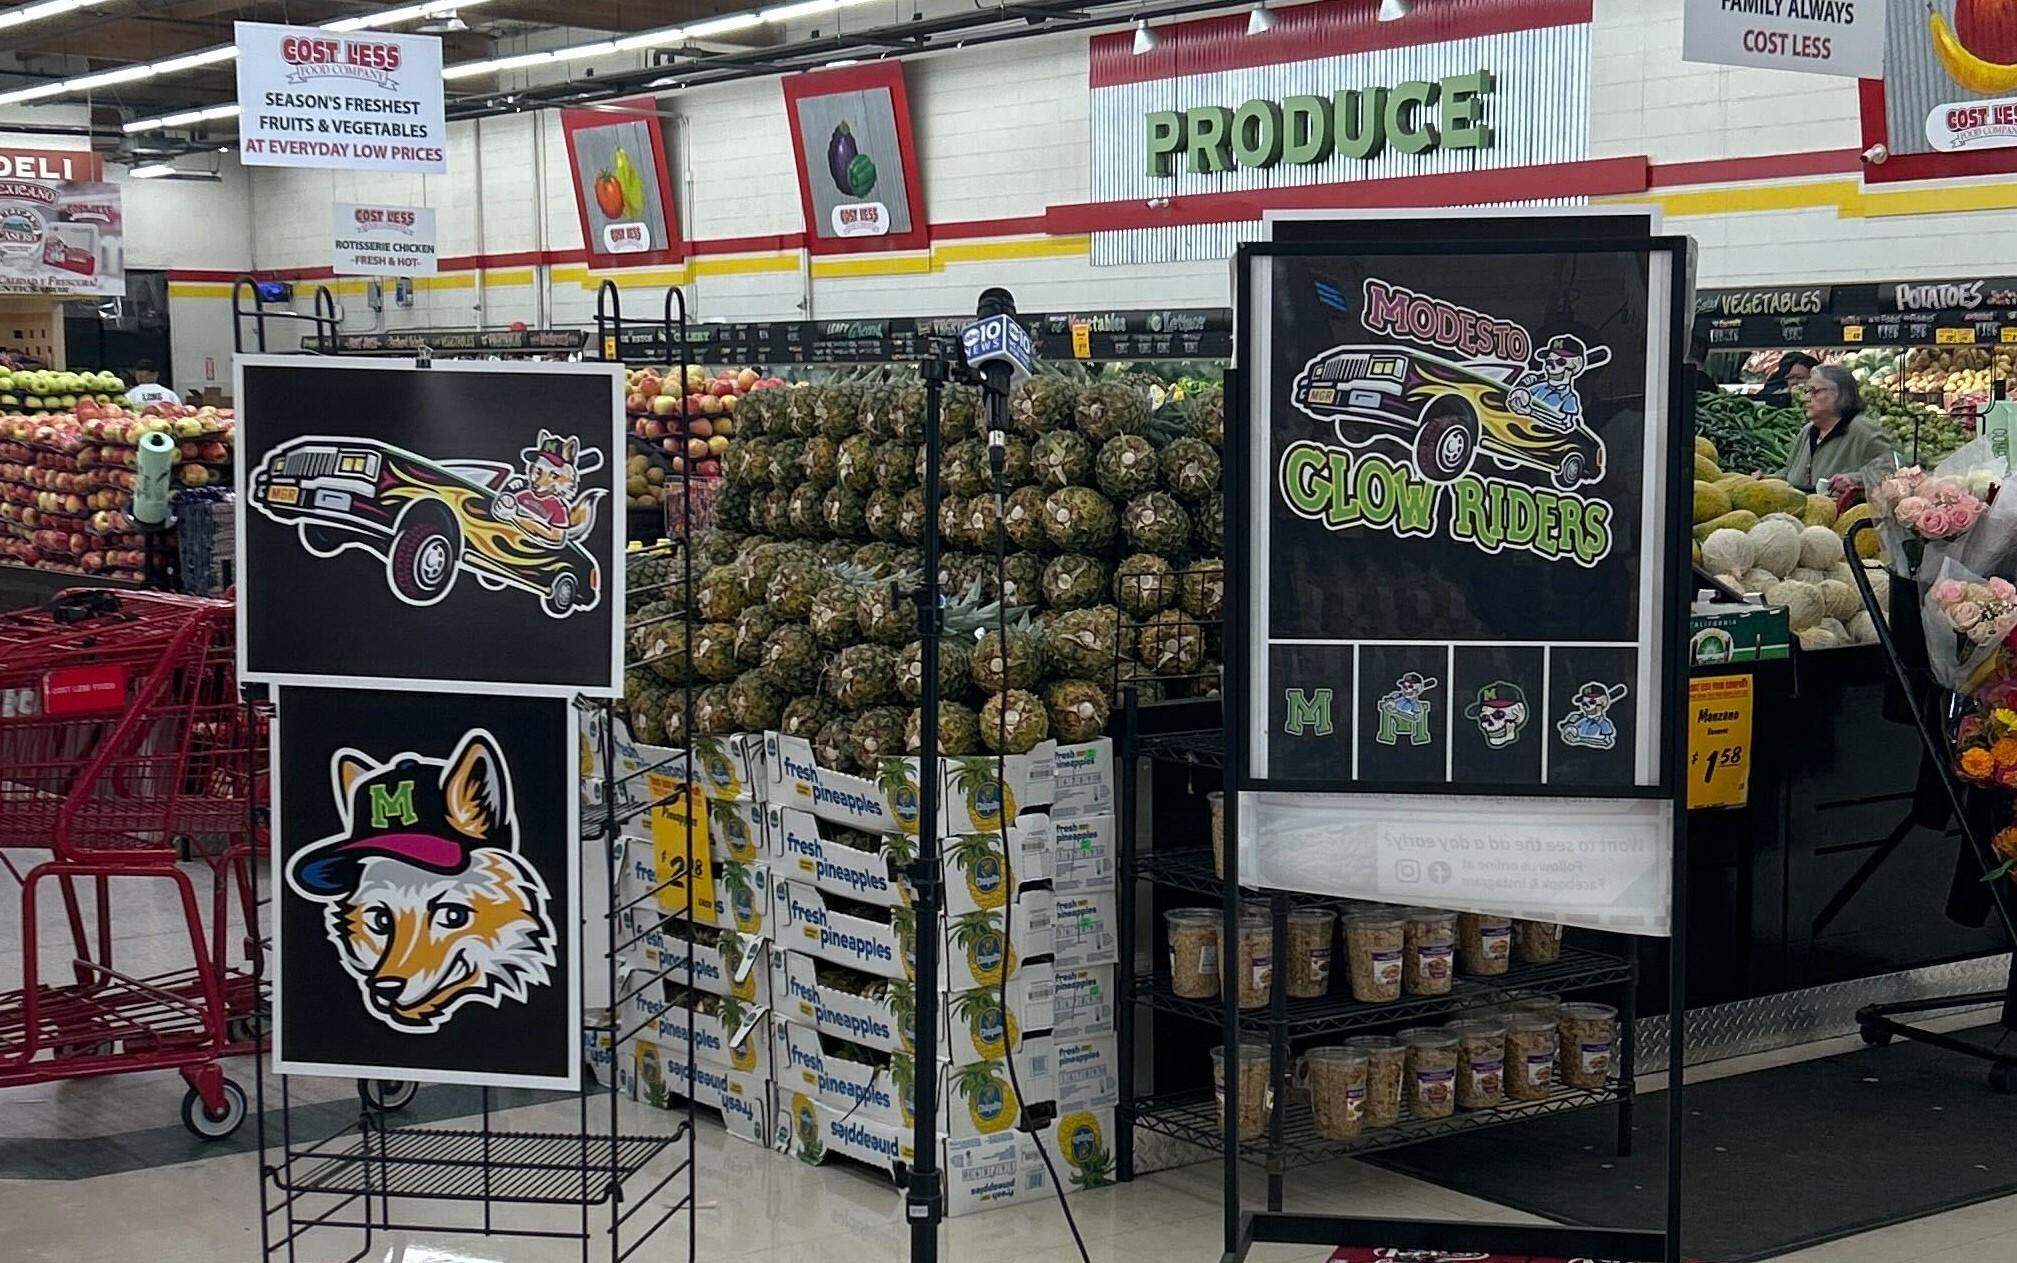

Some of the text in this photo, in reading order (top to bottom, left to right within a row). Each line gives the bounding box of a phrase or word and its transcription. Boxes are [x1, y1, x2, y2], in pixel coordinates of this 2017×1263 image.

[1787, 0, 1854, 24] ALWAYS
[282, 36, 402, 71] COST LESS
[1743, 30, 1831, 59] COST LESS
[299, 65, 329, 76] FOOD
[265, 91, 421, 115] SEASON'S FRESHEST
[259, 115, 428, 139] FRUITS & VEGETABLES
[1145, 68, 1497, 178] PRODUCE
[1947, 108, 1988, 132] COST
[246, 138, 443, 162] AT EVERYDAY LOW PRICES
[355, 209, 415, 226] COST LESS
[335, 240, 435, 254] ROTISSERIE CHICKEN
[1721, 289, 1823, 315] VEGETABLES
[1895, 279, 1985, 312] POTATOES
[1367, 283, 1530, 362] MODESTO
[1284, 446, 1608, 561] GLOW RIDERS
[1285, 688, 1333, 736] M
[784, 756, 819, 783] fresh
[369, 780, 419, 829] M
[812, 781, 882, 816] pineapples
[787, 832, 822, 858] fresh
[635, 861, 656, 883] fre
[816, 856, 888, 892] pineapples
[792, 901, 827, 926] fresh
[820, 924, 892, 961] pineapples
[658, 946, 720, 980] pineaples
[790, 977, 820, 1002] fresh
[658, 1017, 721, 1050] pineaples
[815, 1001, 891, 1038] pineapples
[792, 1044, 824, 1071] fresh
[667, 1059, 728, 1095] pineaples
[818, 1068, 891, 1108] pineapples
[721, 1095, 753, 1121] fresh
[831, 1118, 899, 1160] pineapples
